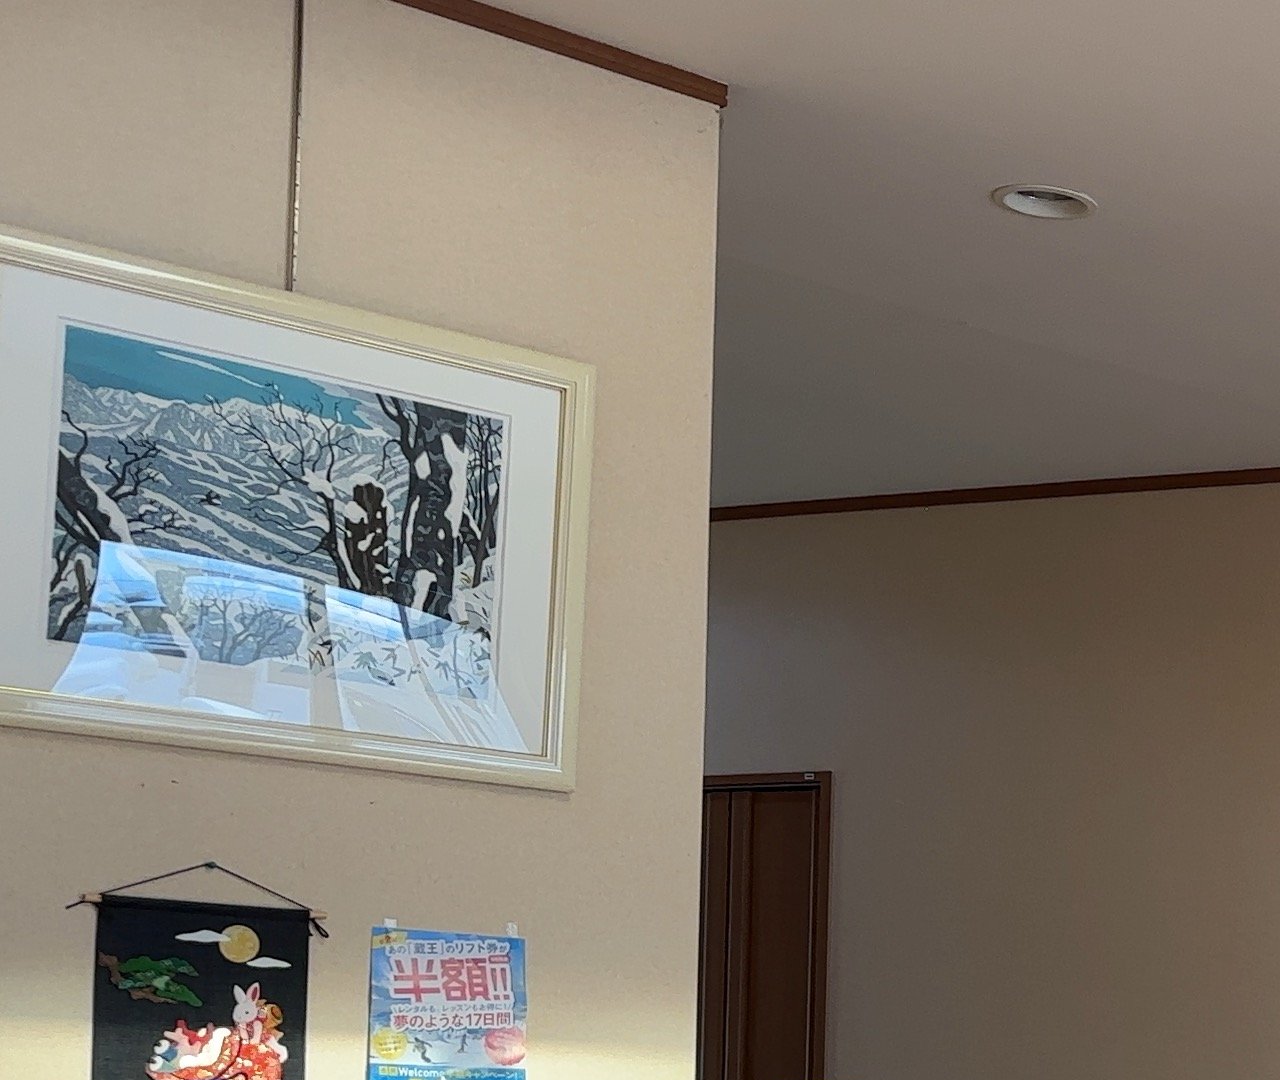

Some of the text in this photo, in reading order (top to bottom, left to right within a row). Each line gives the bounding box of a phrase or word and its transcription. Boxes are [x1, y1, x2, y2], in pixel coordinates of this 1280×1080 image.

[393, 1012, 511, 1028] 夢のような17日間
